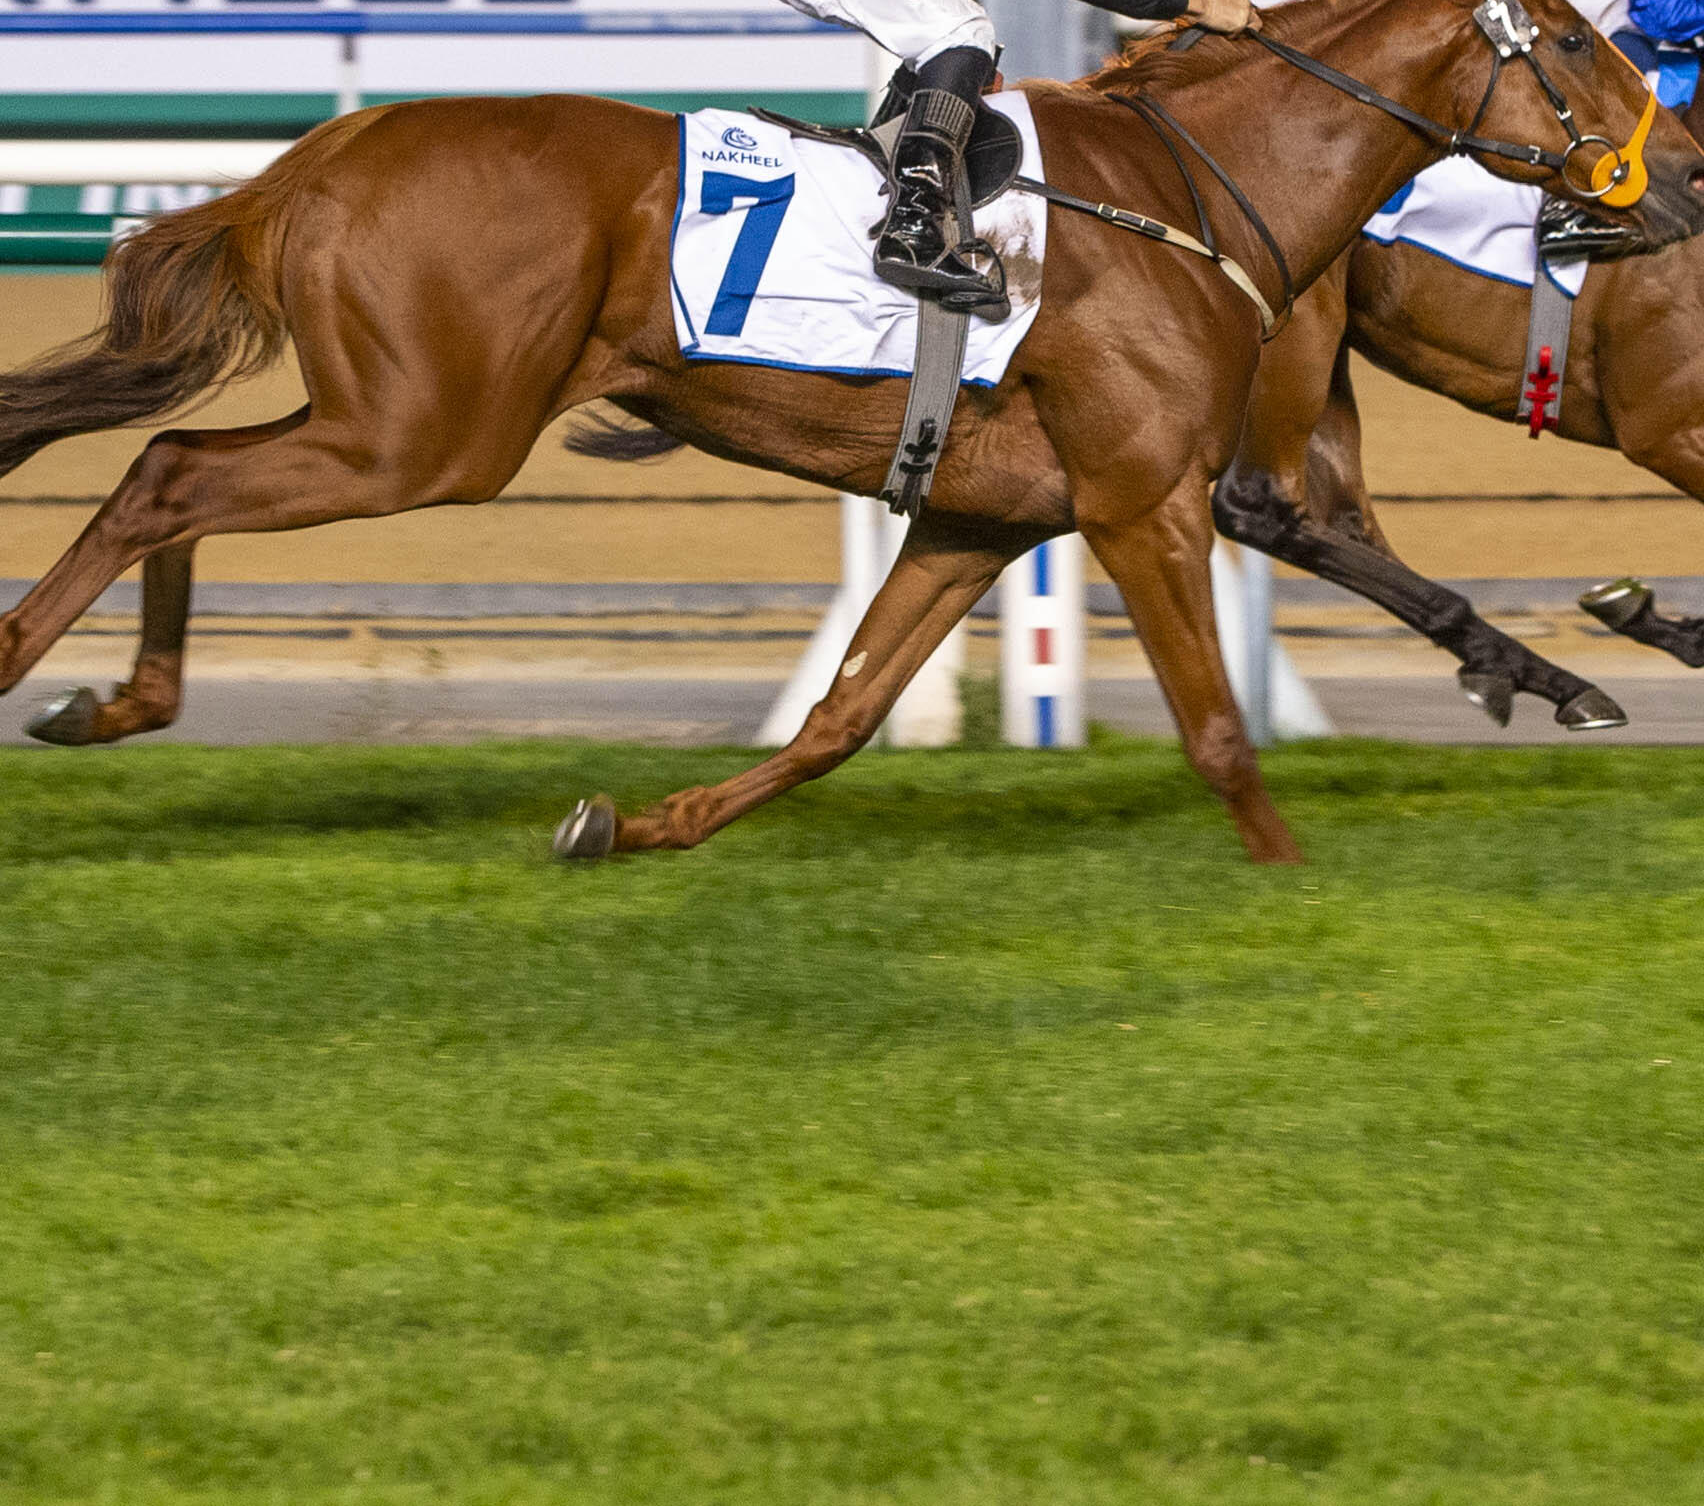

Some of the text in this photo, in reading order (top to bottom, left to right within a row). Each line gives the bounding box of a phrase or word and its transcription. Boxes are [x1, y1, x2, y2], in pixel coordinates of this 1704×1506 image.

[1487, 1, 1519, 43] 7
[701, 149, 784, 169] NAKHEEL
[699, 170, 796, 338] 7
